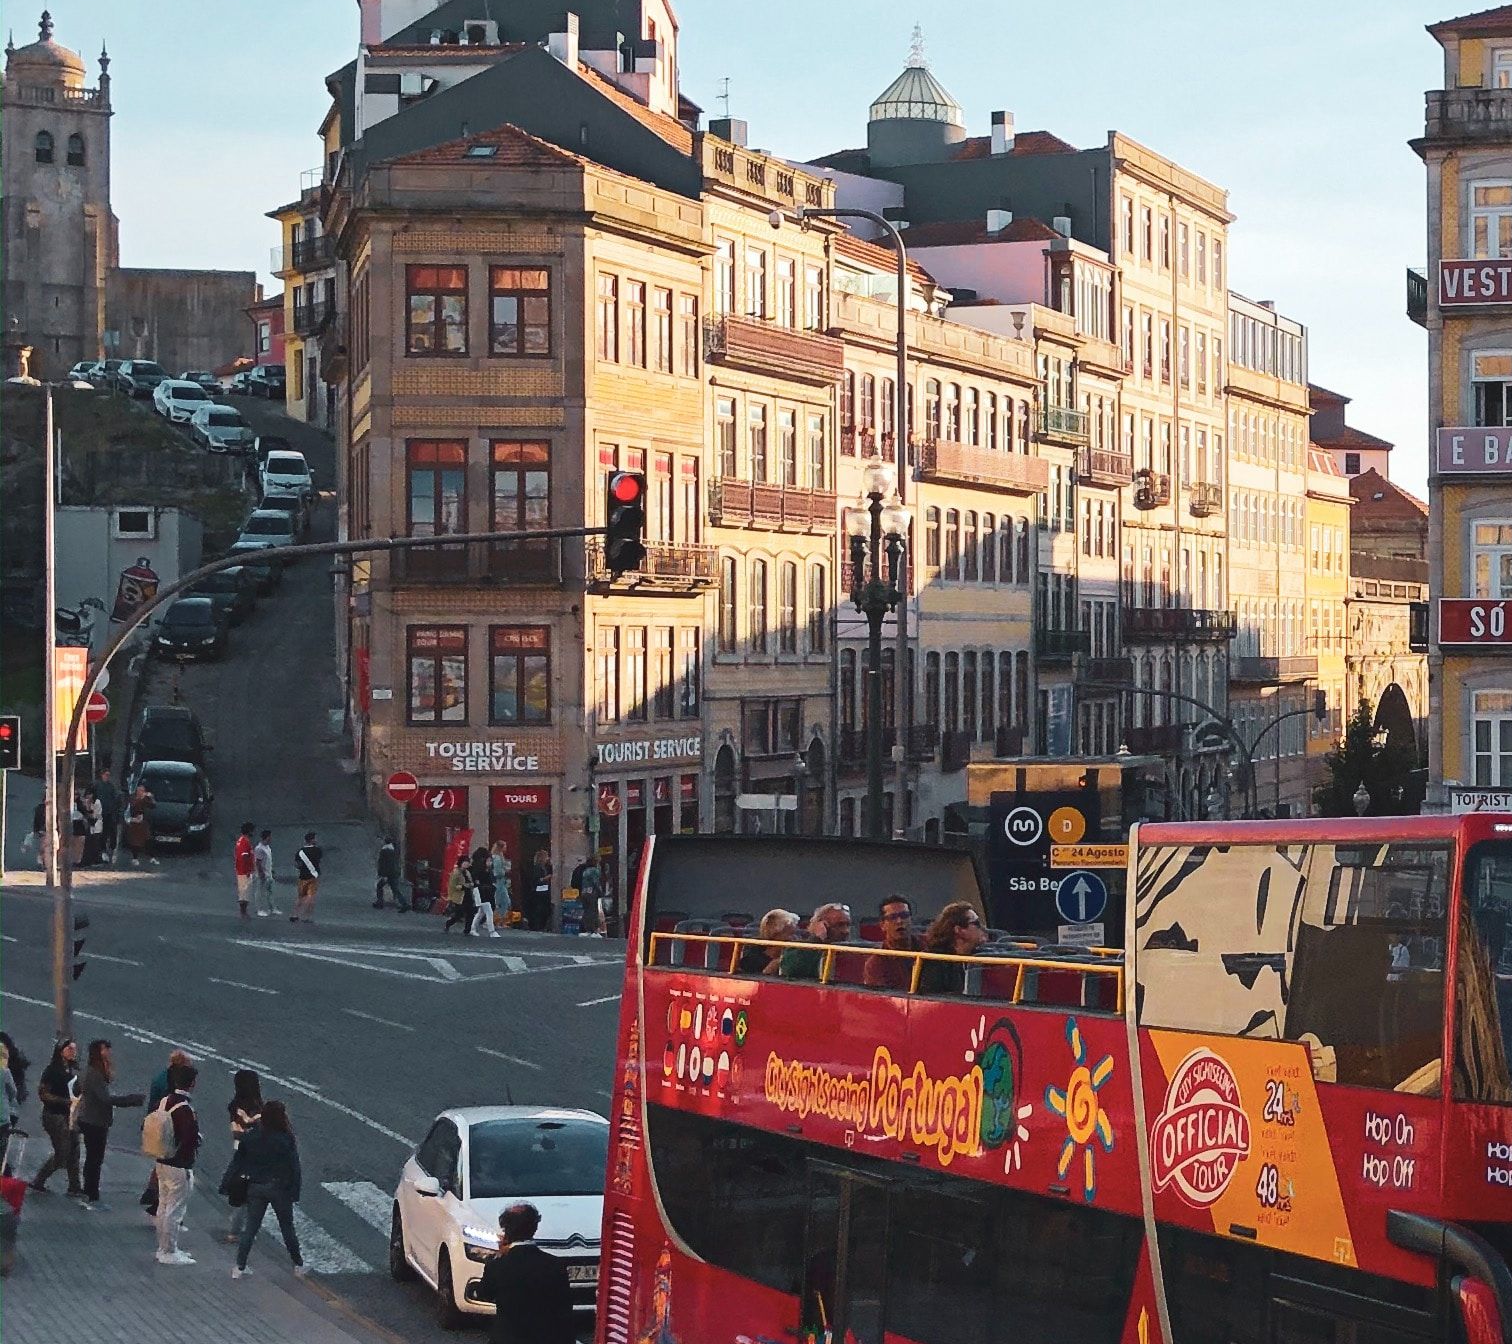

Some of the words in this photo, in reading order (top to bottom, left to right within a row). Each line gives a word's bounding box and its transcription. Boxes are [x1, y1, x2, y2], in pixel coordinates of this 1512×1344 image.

[1452, 435, 1465, 465] E
[1470, 602, 1505, 637] SÓ
[425, 742, 516, 757] TOURIST
[452, 756, 538, 771] SERVICE
[597, 741, 650, 764] TOURIST
[653, 737, 701, 760] SERVICE
[504, 794, 538, 804] TOURS
[1062, 819, 1072, 833] D
[1072, 847, 1084, 857] 24
[1086, 847, 1125, 859] Agosto
[1009, 876, 1036, 891] São
[1040, 877, 1061, 891] Be
[870, 1045, 984, 1166] Portugal
[1162, 1108, 1248, 1167] OFFICIAL
[1365, 1111, 1392, 1146] Hop
[1395, 1113, 1414, 1146] On
[1192, 1156, 1229, 1191] TOUR
[1362, 1153, 1389, 1187] Hop
[1393, 1155, 1415, 1188] Off
